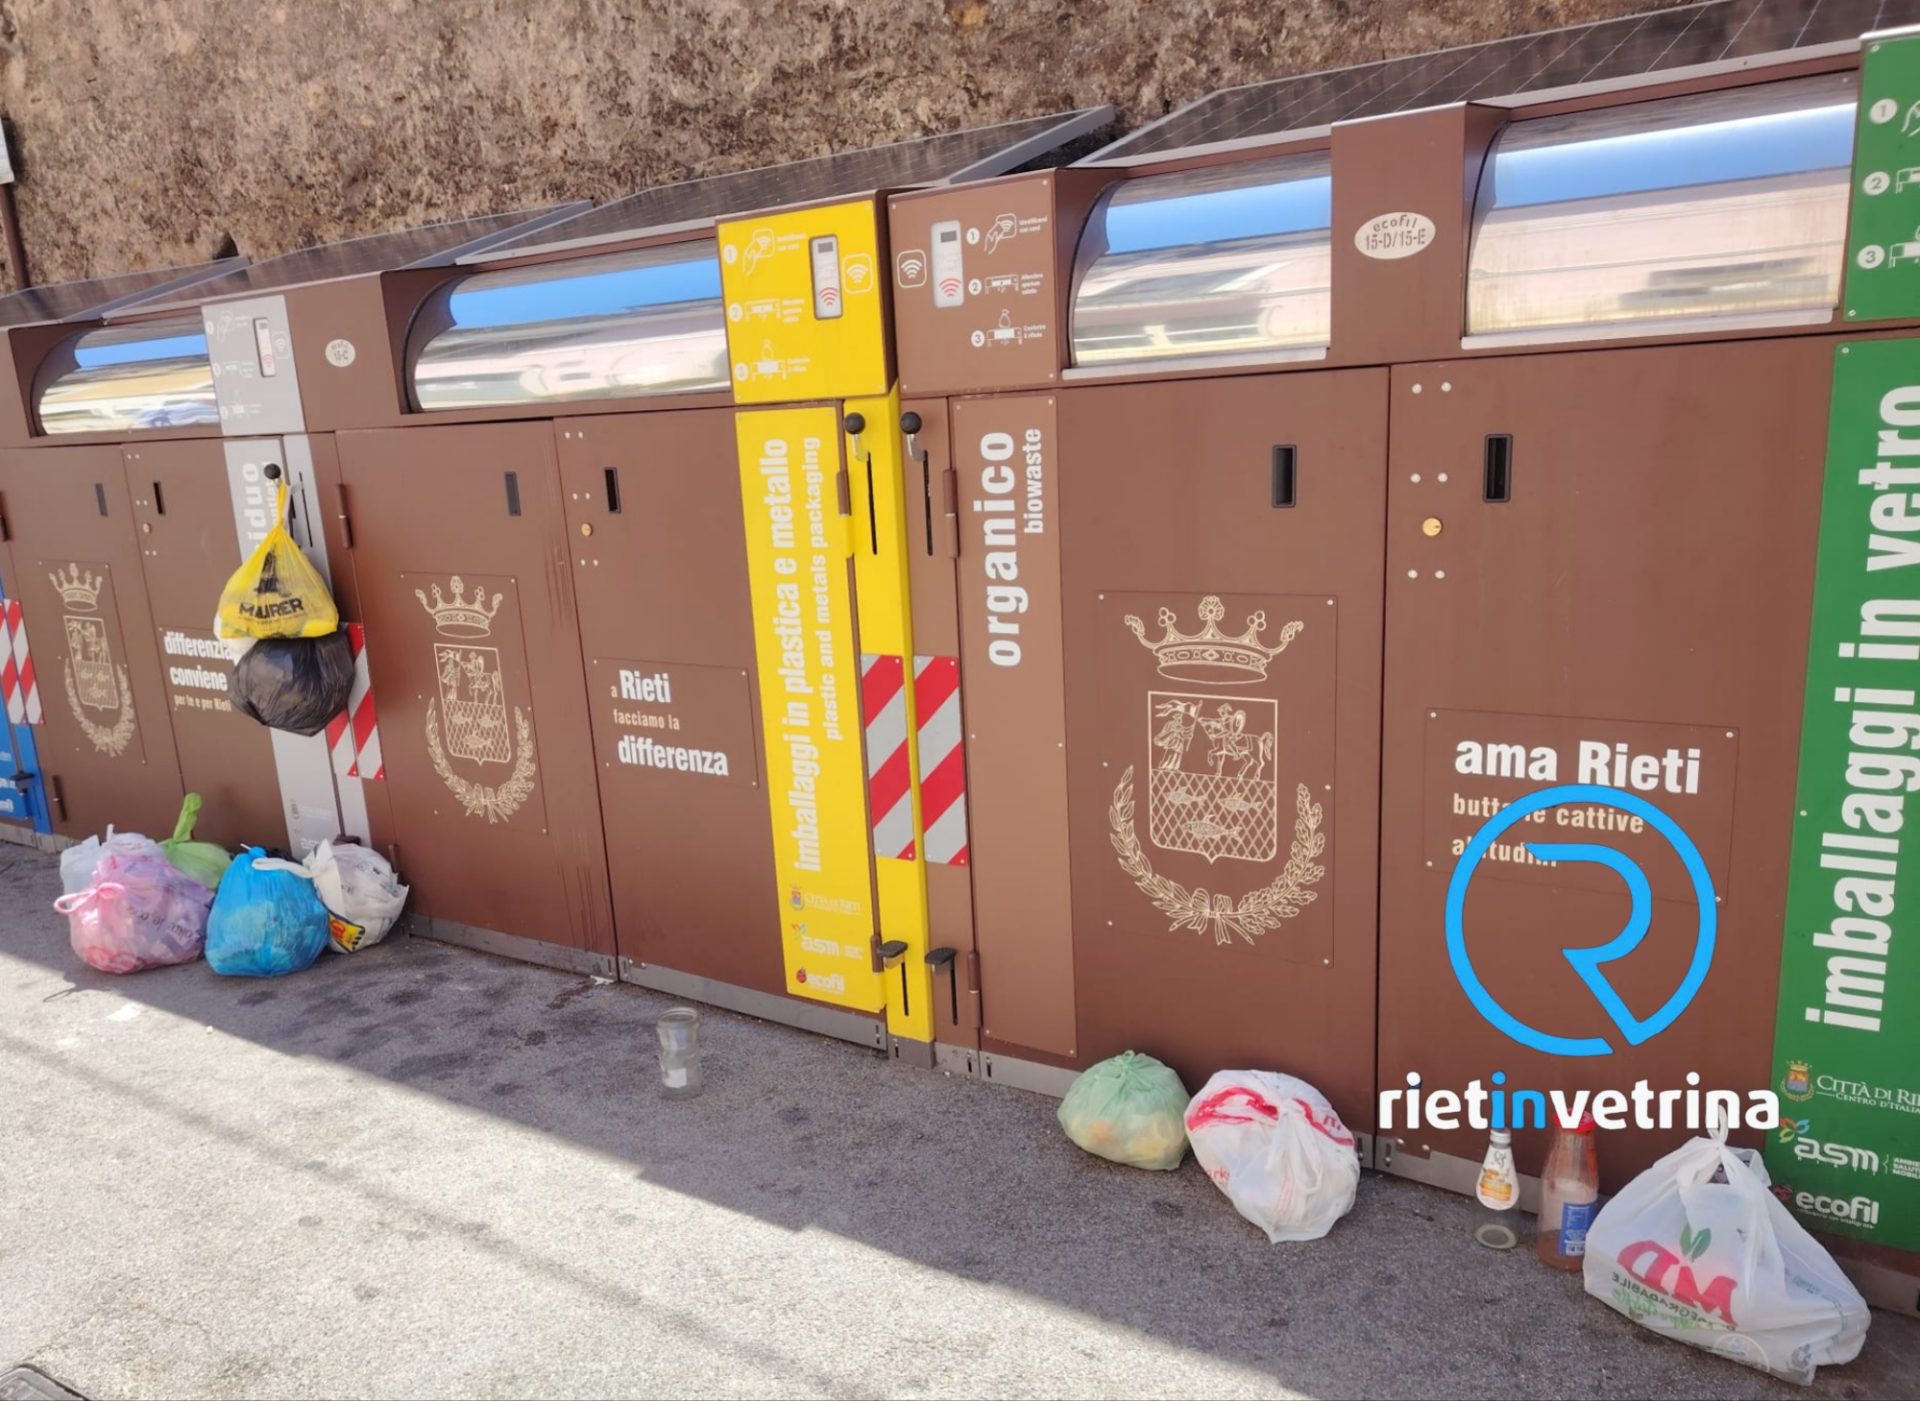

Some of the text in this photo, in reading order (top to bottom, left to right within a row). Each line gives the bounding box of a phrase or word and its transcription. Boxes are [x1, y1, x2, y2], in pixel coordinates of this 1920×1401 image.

[1366, 228, 1426, 251] 15-D/15-E
[1373, 214, 1418, 232] ecofil
[1022, 428, 1044, 534] biowaste
[973, 432, 1029, 667] organico
[801, 437, 844, 742] plastic and metals packaging
[759, 439, 822, 873] imballaggi in plastica e metallo
[169, 665, 229, 691] conviene
[610, 669, 671, 703] a Rieti
[613, 708, 680, 730] facciamo la
[1805, 385, 1920, 1032] imballaggi in vetro
[618, 735, 729, 776] differenza
[1455, 740, 1700, 795] ama Rieti
[1453, 793, 1512, 819] butt
[1556, 807, 1645, 834] cattive
[1817, 1075, 1869, 1099] CITTÀ
[1875, 1087, 1892, 1101] DI
[1836, 1092, 1877, 1107] CENTRO
[1794, 1136, 1880, 1177] asm
[1796, 1191, 1880, 1225] ecofil
